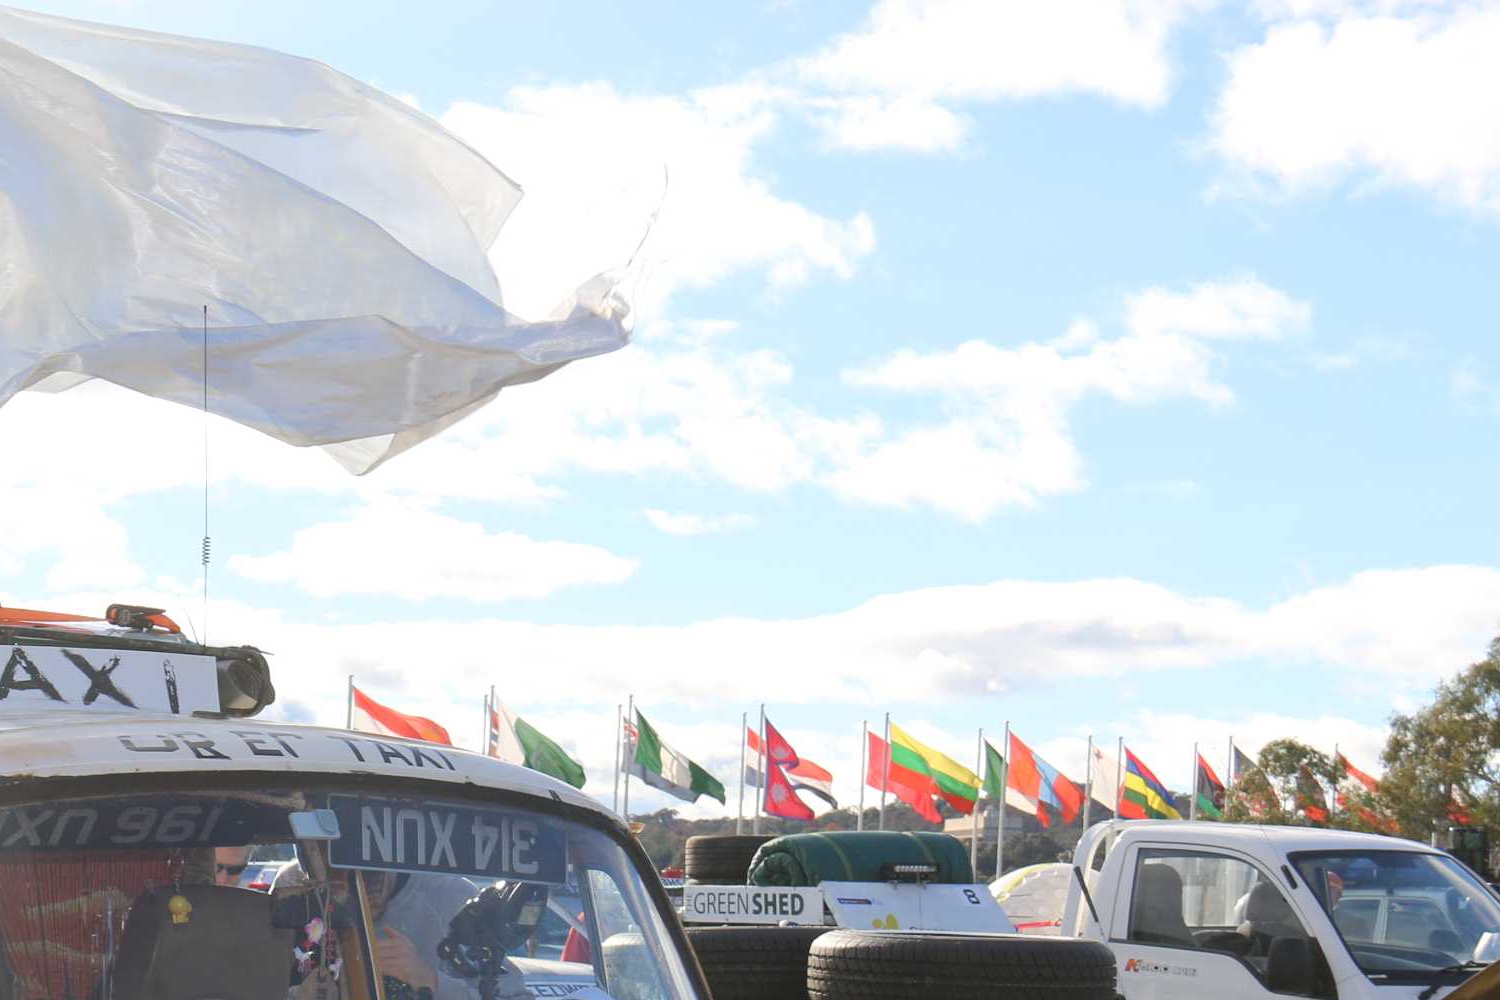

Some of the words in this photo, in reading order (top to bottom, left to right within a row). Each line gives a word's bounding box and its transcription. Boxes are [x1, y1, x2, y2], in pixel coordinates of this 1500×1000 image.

[693, 892, 749, 914] GREEN
[752, 893, 804, 915] SHED
[963, 889, 980, 905] 8
